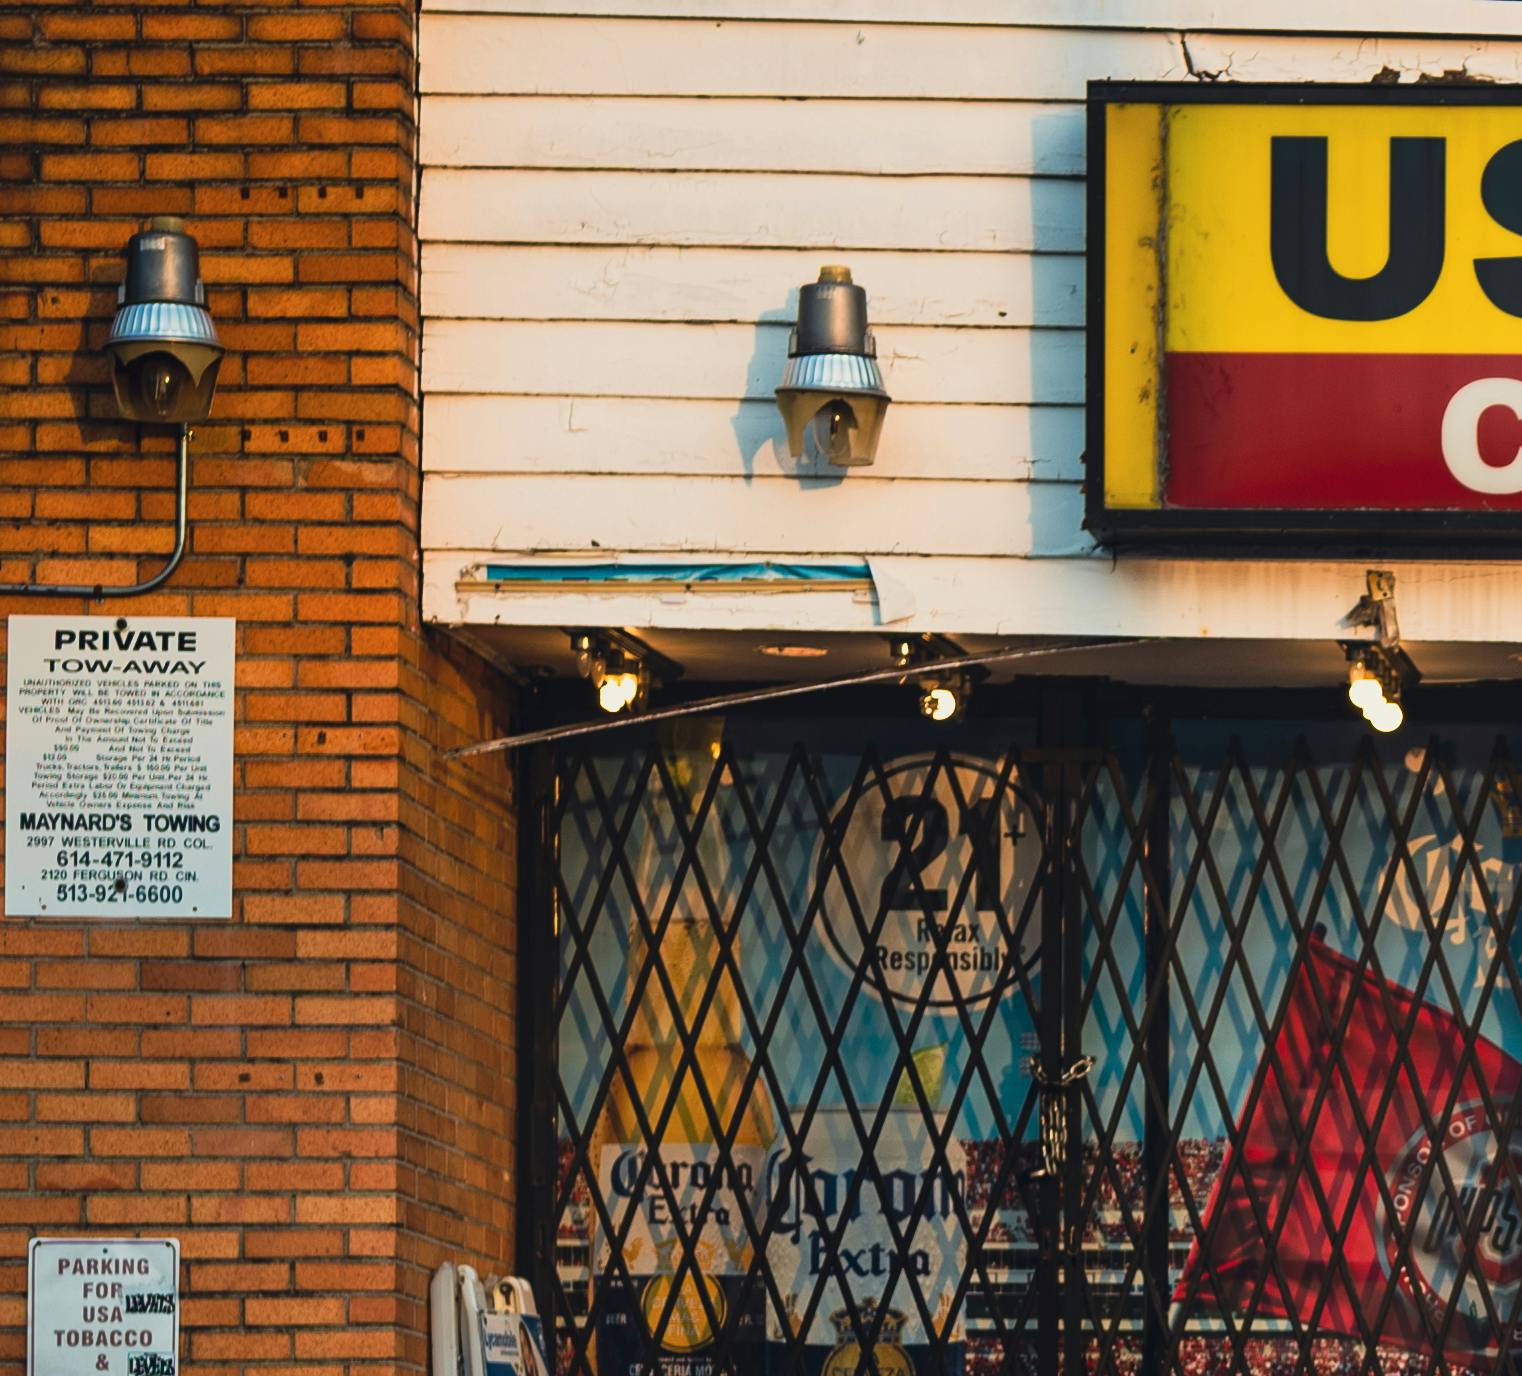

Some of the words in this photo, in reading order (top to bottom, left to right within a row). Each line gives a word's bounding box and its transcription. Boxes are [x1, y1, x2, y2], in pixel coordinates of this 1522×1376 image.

[54, 629, 197, 652] PRIVATE
[43, 659, 207, 676] TOW-AWAY
[19, 688, 66, 697] PROPERTY
[73, 689, 93, 697] WILL
[98, 689, 109, 697] BE
[115, 689, 147, 698] TOWED
[165, 690, 225, 698] ACCORDANCE
[23, 679, 92, 688] UNAUTHORIZED
[97, 680, 139, 688] VEHICLES
[144, 680, 180, 688] PARKED
[203, 681, 222, 689] THIS
[18, 706, 61, 714] VEHICLES
[41, 698, 64, 706] WITH
[19, 812, 133, 832] MAYNARD'S
[143, 814, 221, 832] TOWING
[26, 836, 55, 847] 2997
[61, 837, 151, 849] WESTERVILLE
[157, 838, 176, 848] RD
[56, 850, 184, 868] 614-471-9112
[40, 869, 68, 880] 2120
[72, 869, 143, 882] FERGUSON
[149, 870, 168, 881] RD
[56, 884, 183, 904] 513-921-6600
[917, 918, 981, 943] Reax
[874, 946, 1014, 976] Respnsibl
[611, 1148, 755, 1199] Corona
[647, 1195, 731, 1227] Extra
[808, 1229, 931, 1277] Extra
[57, 1257, 150, 1276] PARKING
[82, 1282, 123, 1299] FOR
[82, 1305, 123, 1323] USA
[54, 1329, 153, 1347] TOBACCO
[95, 1353, 109, 1371] &
